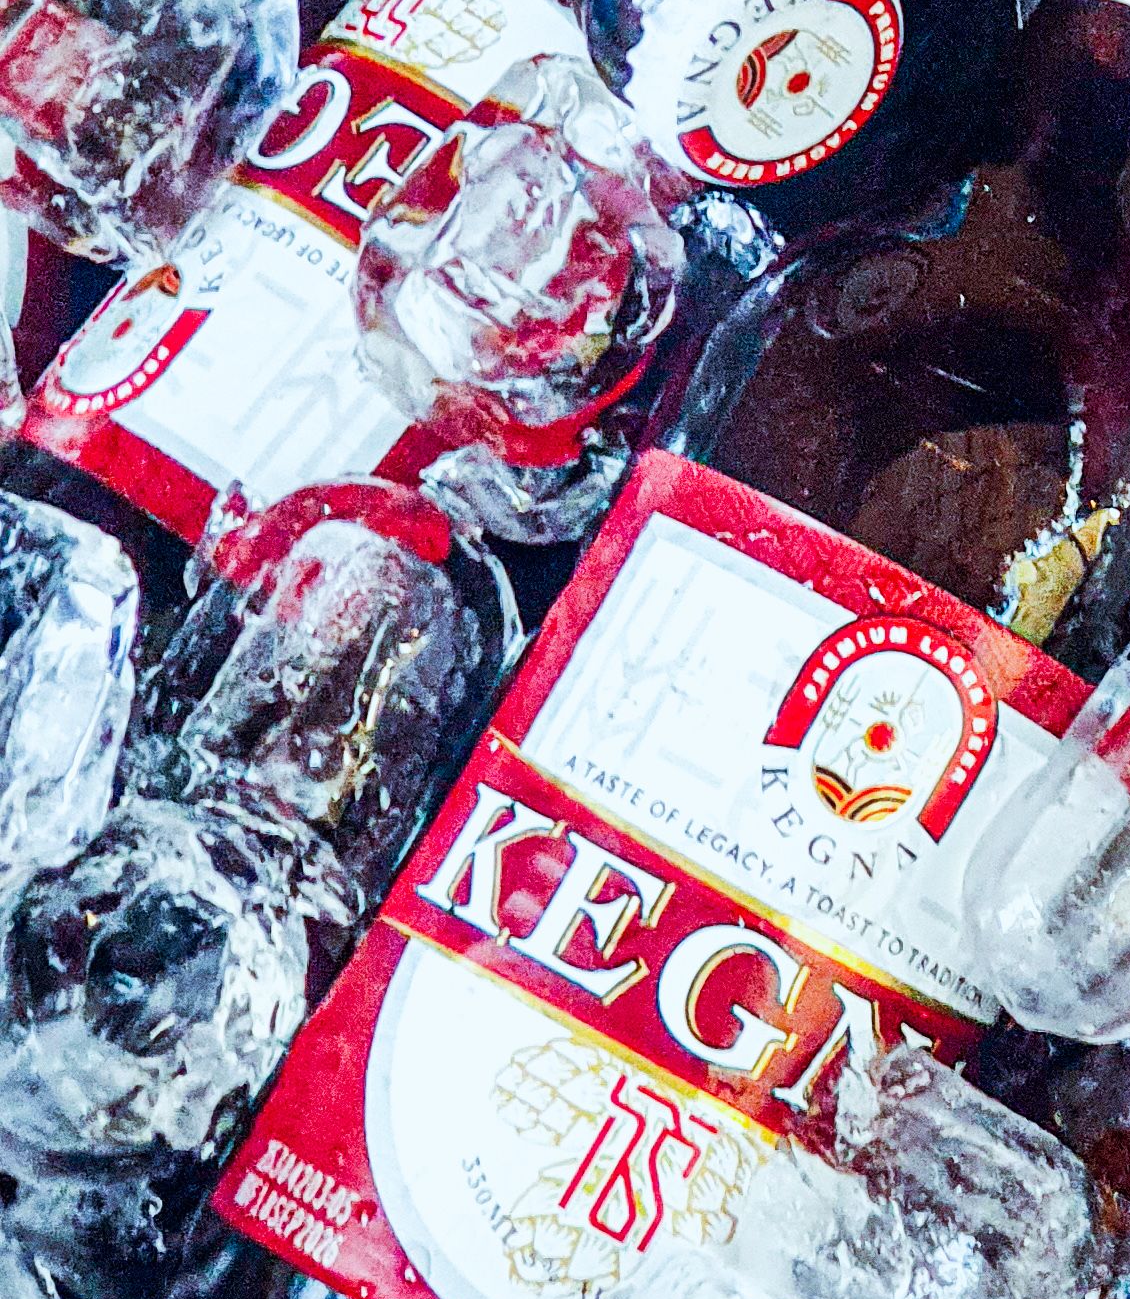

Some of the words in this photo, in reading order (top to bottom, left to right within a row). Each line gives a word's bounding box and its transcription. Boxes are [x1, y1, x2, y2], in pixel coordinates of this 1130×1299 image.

[565, 755, 577, 773] A
[587, 761, 645, 806] TASTE
[649, 800, 680, 824] OF
[780, 876, 796, 895] A
[806, 885, 873, 936] TOAST
[877, 927, 904, 955] TO
[761, 765, 918, 880] KEGNA
